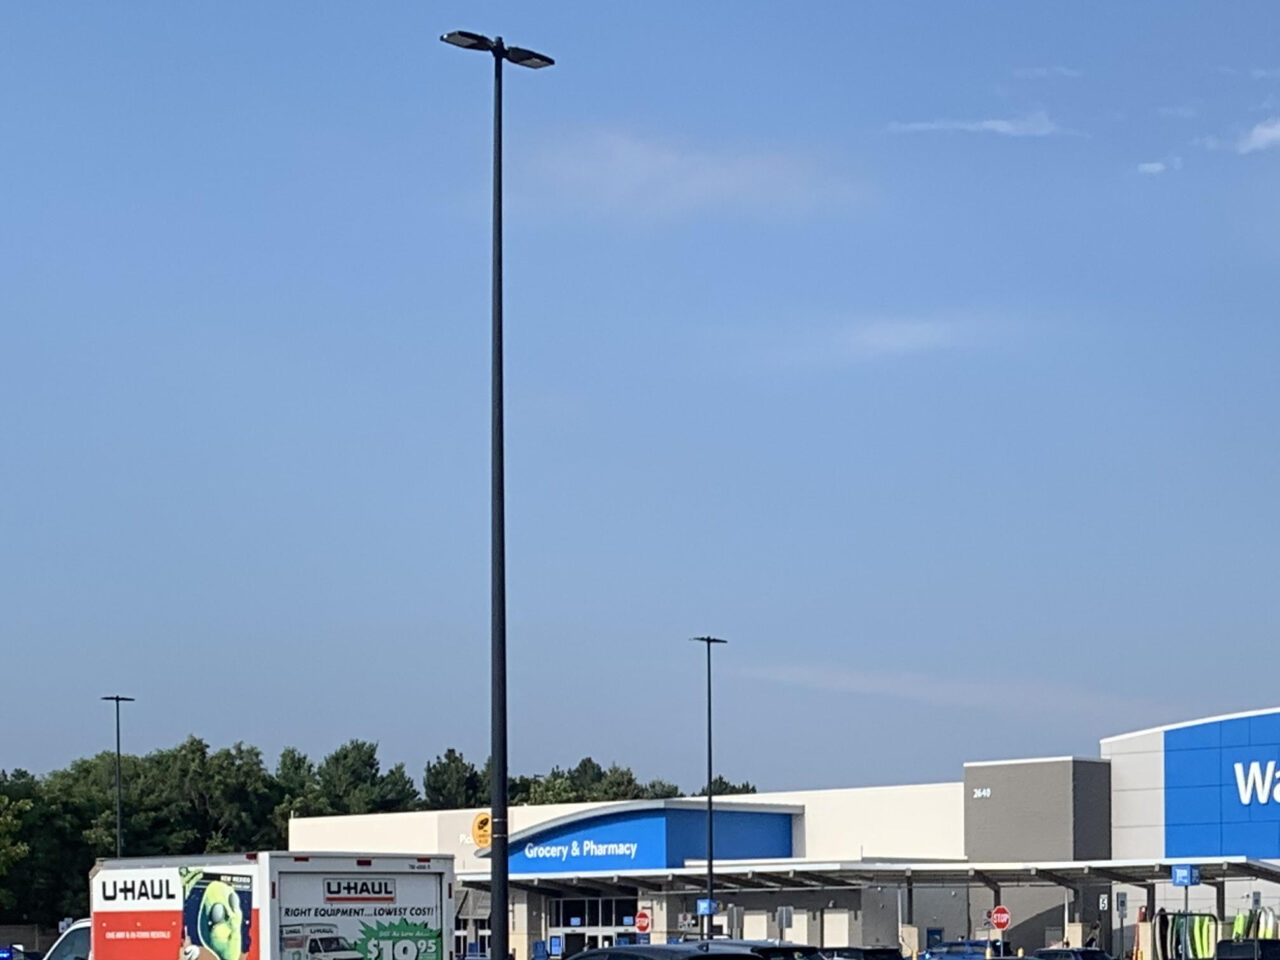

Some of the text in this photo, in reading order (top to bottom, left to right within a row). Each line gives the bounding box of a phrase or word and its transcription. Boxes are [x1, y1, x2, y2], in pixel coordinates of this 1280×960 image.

[525, 841, 638, 861] Grocery & Pharmacy
[102, 879, 176, 900] U-HAUL
[327, 881, 393, 894] U-HAUL
[284, 908, 312, 917] RIGHT
[373, 907, 407, 916] LOWEST
[994, 912, 1009, 922] STOP
